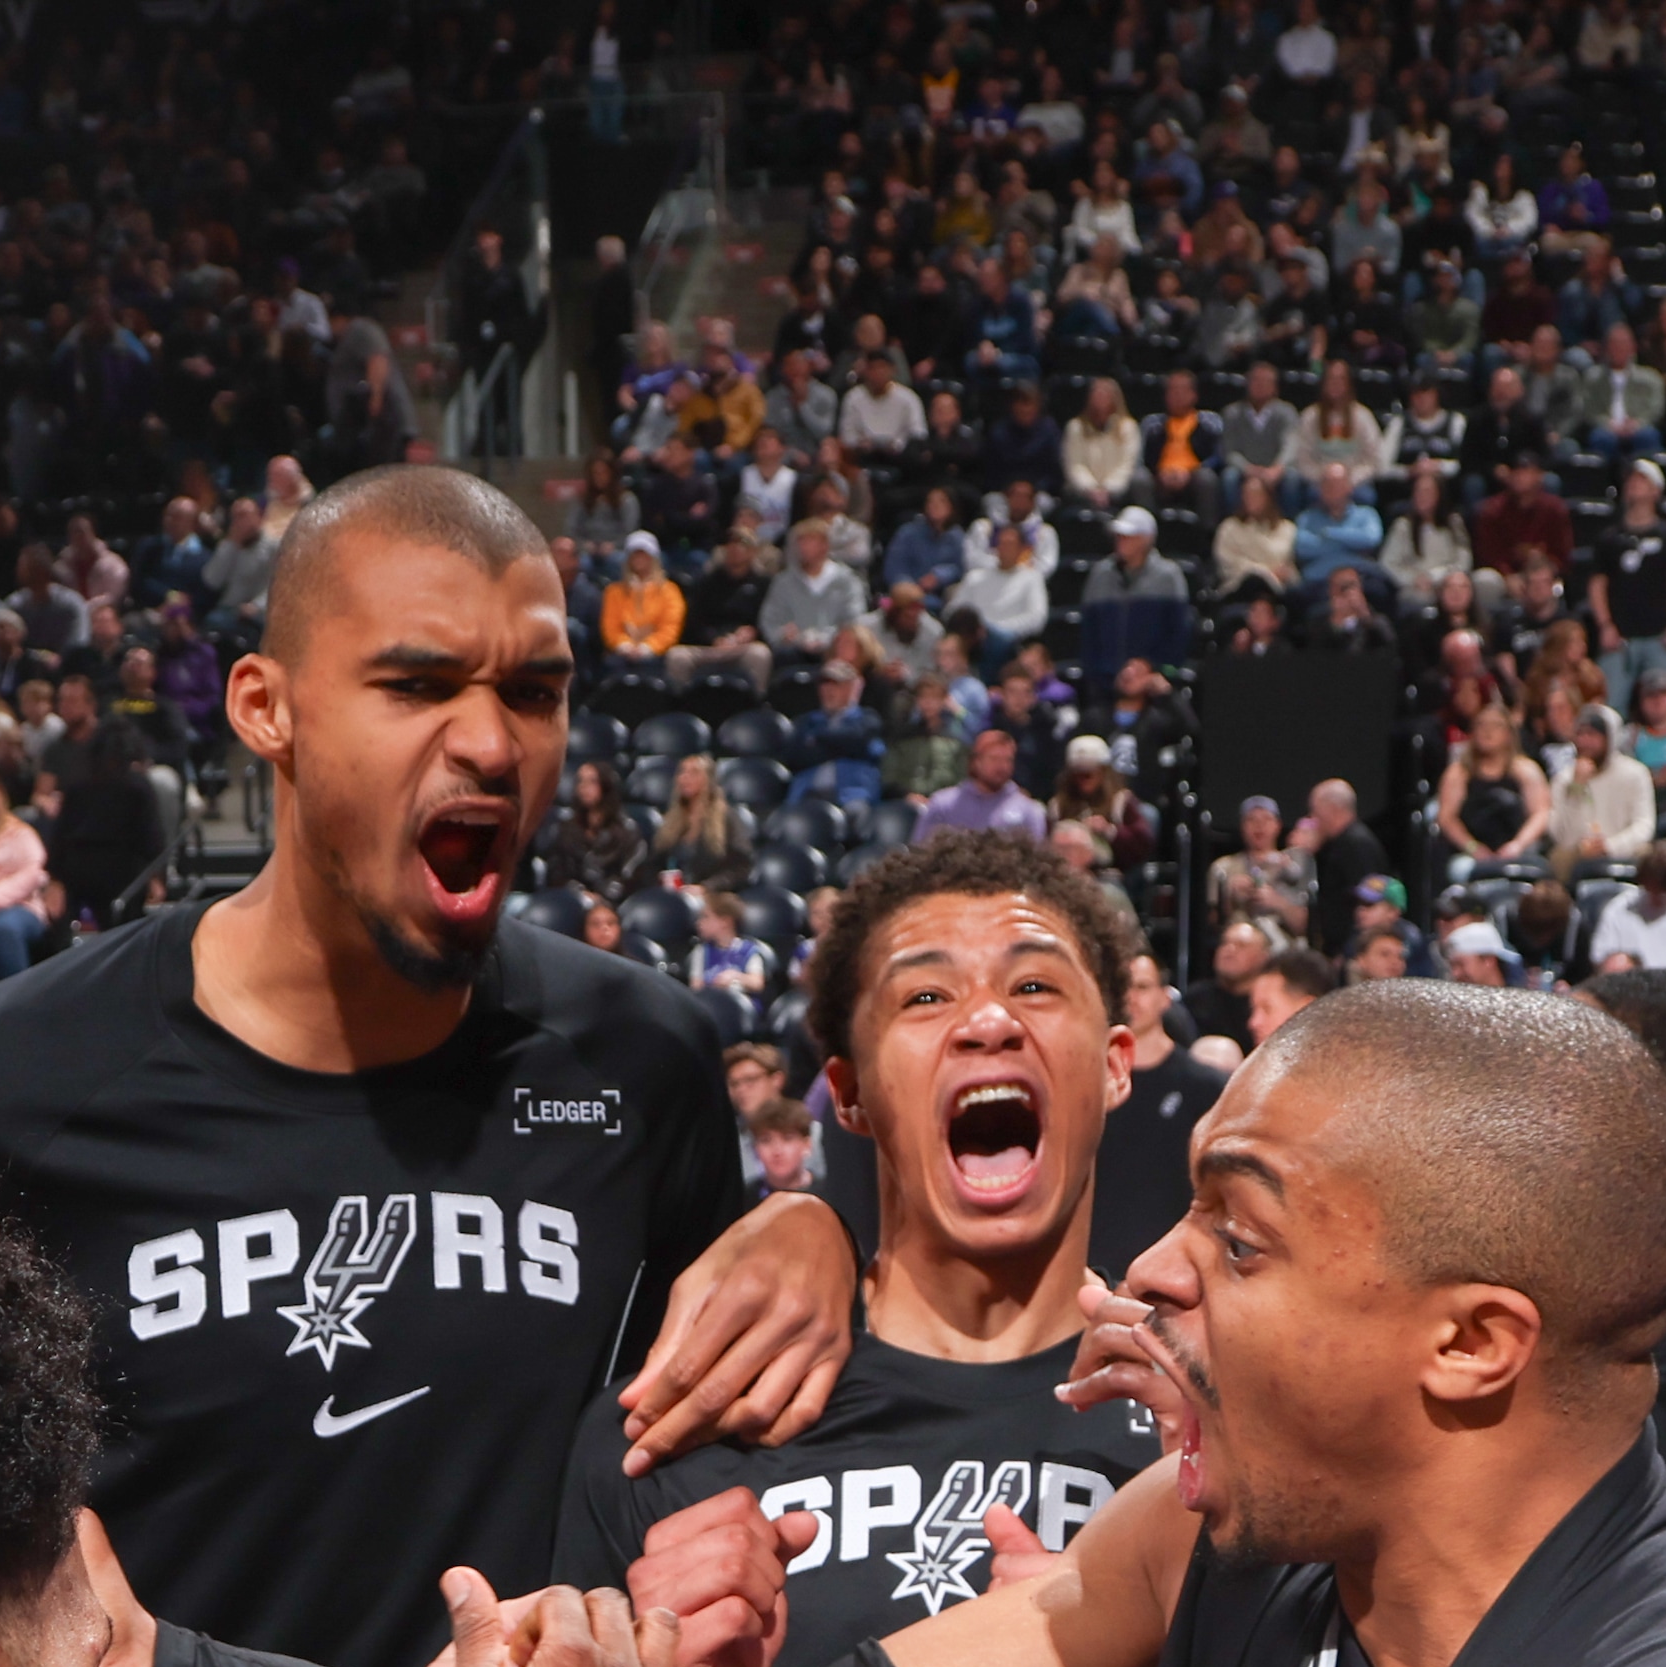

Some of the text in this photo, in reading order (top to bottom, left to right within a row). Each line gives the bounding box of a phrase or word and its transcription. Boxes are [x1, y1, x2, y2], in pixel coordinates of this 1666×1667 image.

[527, 1099, 607, 1124] LEDGER
[128, 1193, 580, 1371] SPURS
[759, 1460, 1118, 1616] SPUR
